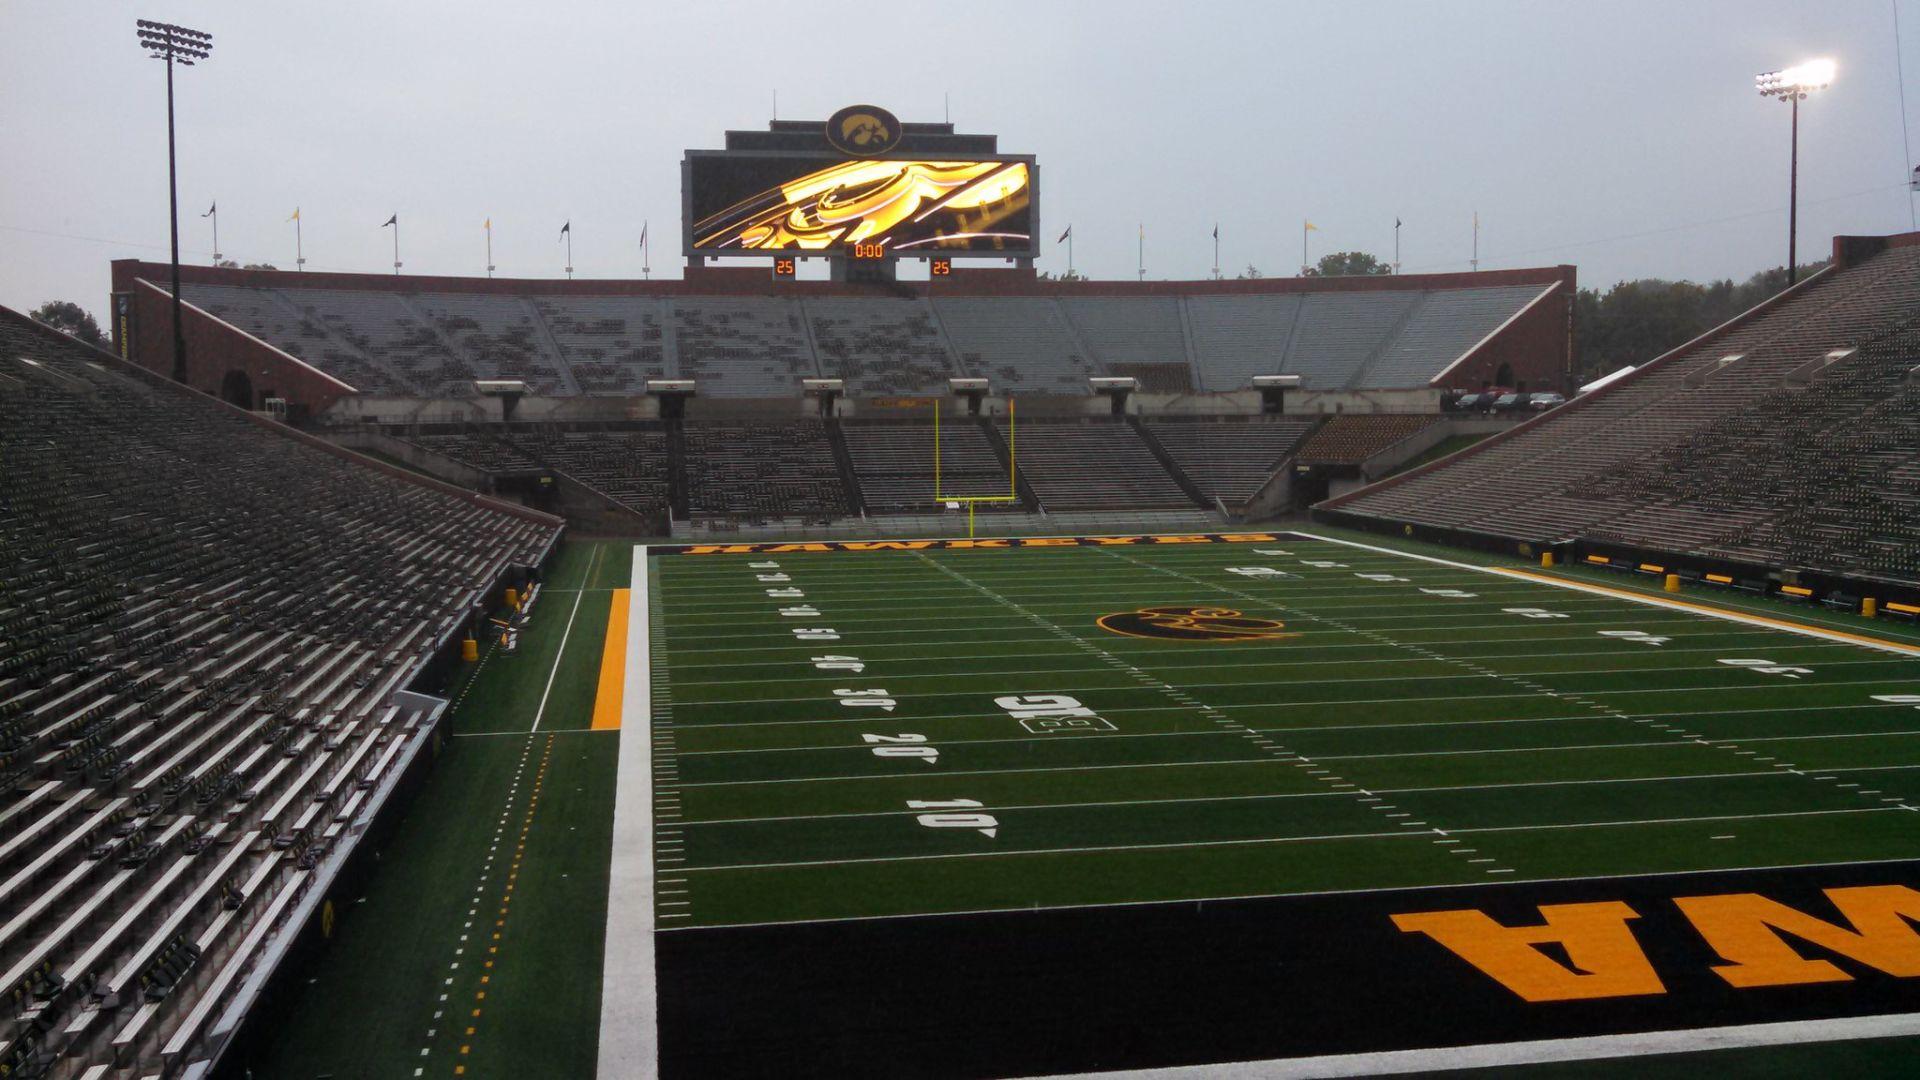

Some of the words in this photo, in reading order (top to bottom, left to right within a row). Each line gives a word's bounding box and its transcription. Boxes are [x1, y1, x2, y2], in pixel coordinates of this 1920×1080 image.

[855, 244, 883, 258] 0:00
[777, 260, 793, 274] 25
[933, 261, 949, 275] 25
[684, 533, 1276, 554] HAWKEYES
[832, 688, 897, 707] 30
[861, 734, 940, 757] 20
[906, 799, 999, 828] 10
